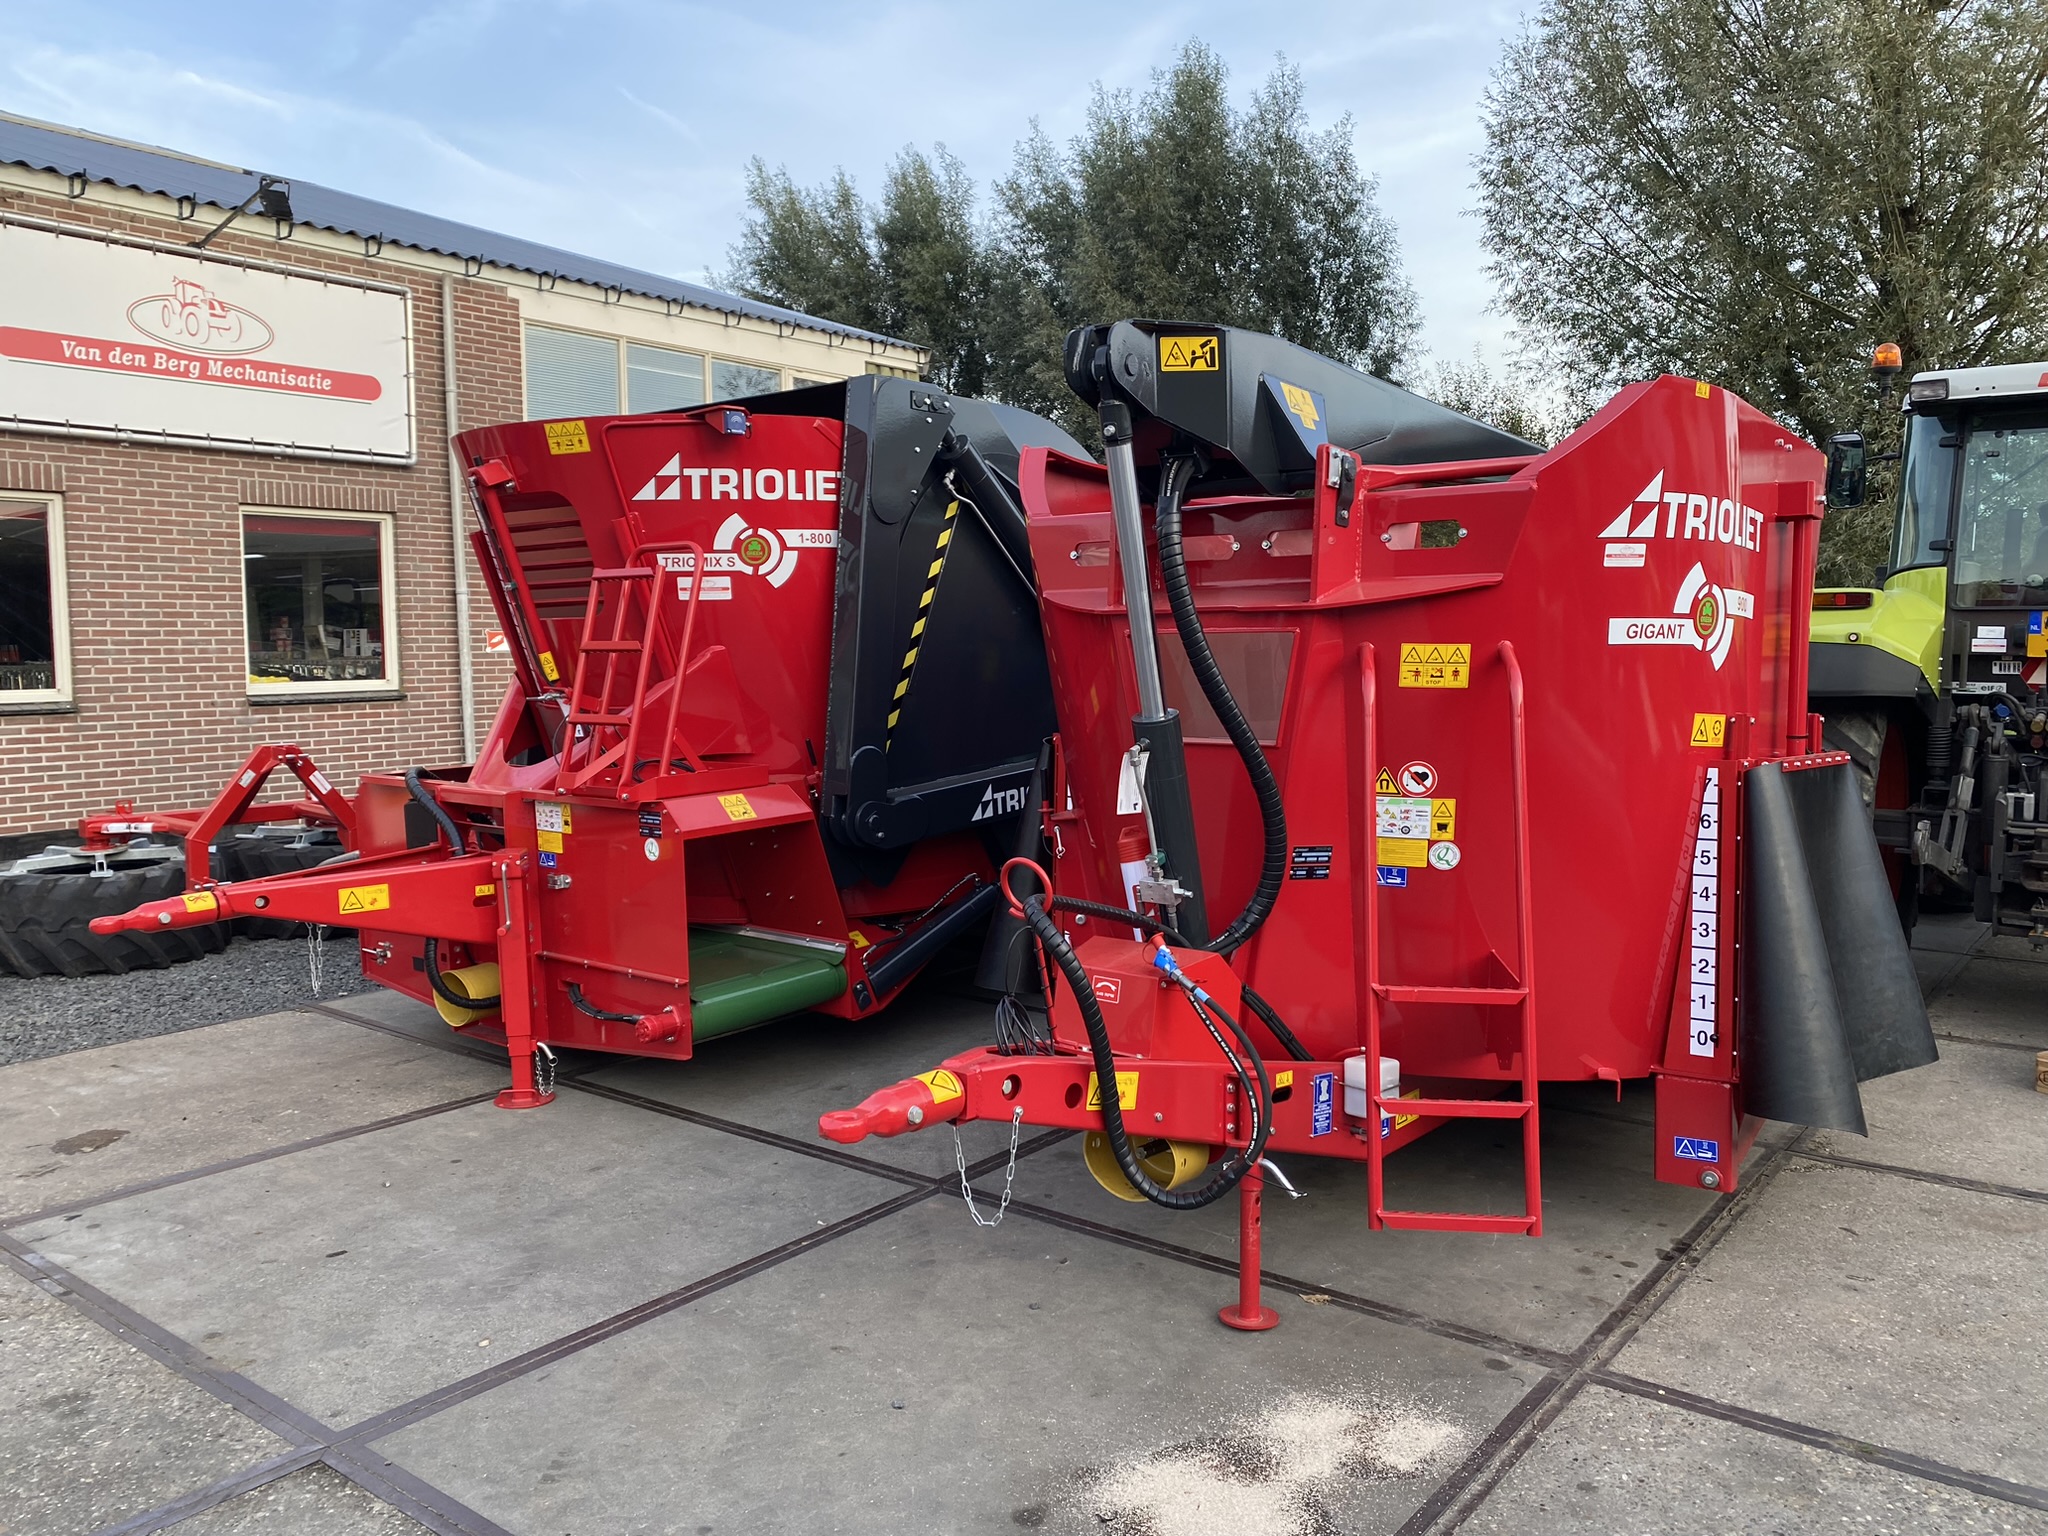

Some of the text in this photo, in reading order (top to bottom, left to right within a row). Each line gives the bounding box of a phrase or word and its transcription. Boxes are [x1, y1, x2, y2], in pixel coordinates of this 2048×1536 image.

[61, 340, 332, 390] Van den Berg Mechanisatie
[1663, 491, 1764, 553] TRIOLIET
[798, 533, 832, 544] 1-800
[726, 557, 736, 568] S
[1626, 623, 1685, 640] GIGANT
[1704, 777, 1713, 793] 7
[1700, 813, 1712, 829] 6
[1700, 849, 1711, 865] 5
[1699, 886, 1711, 901] 4
[1698, 922, 1710, 938] 3
[1698, 958, 1710, 974] 2
[1698, 994, 1706, 1010] 1
[1696, 1030, 1708, 1046] 0
